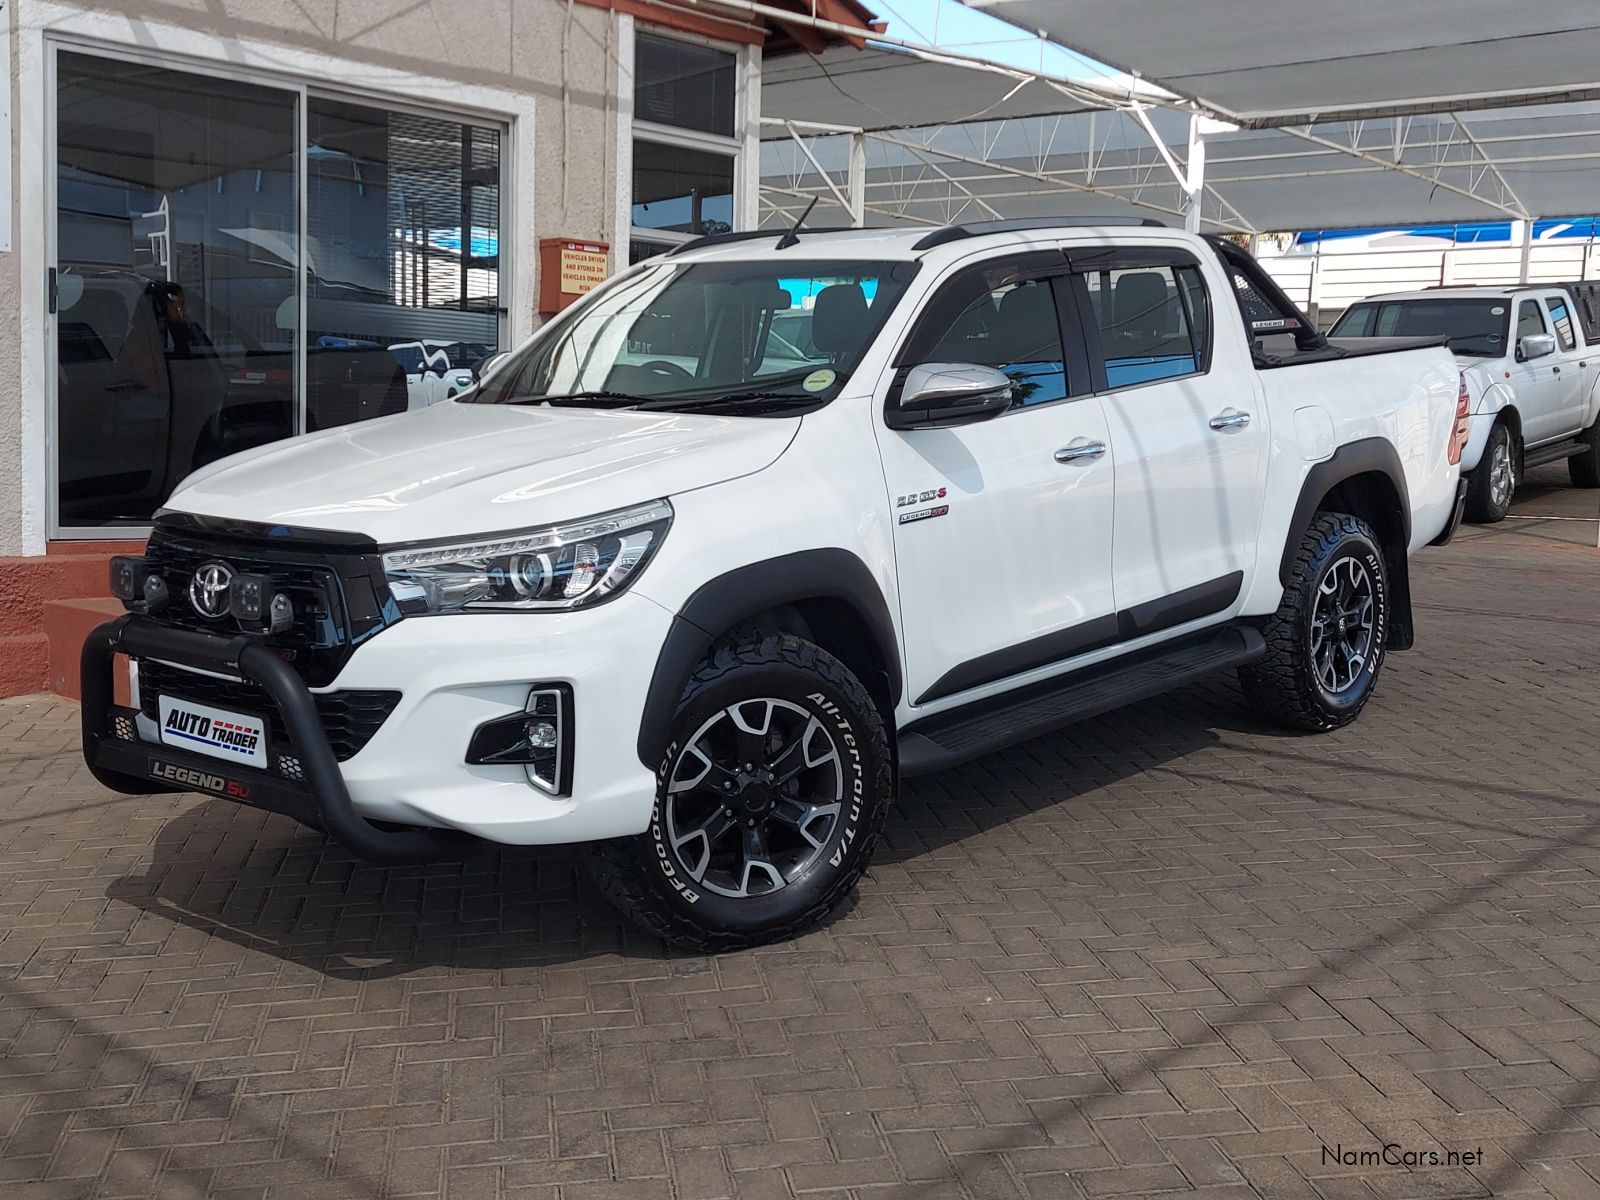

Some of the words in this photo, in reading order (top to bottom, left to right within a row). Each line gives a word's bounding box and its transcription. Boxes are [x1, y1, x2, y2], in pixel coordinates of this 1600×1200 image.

[577, 264, 596, 272] STORED
[902, 510, 931, 521] LEGEND
[165, 708, 211, 737] AUTO
[212, 726, 258, 750] TRADER
[806, 691, 864, 817] All-Terrain
[153, 761, 225, 791] LEGEND
[829, 827, 857, 868] T/A
